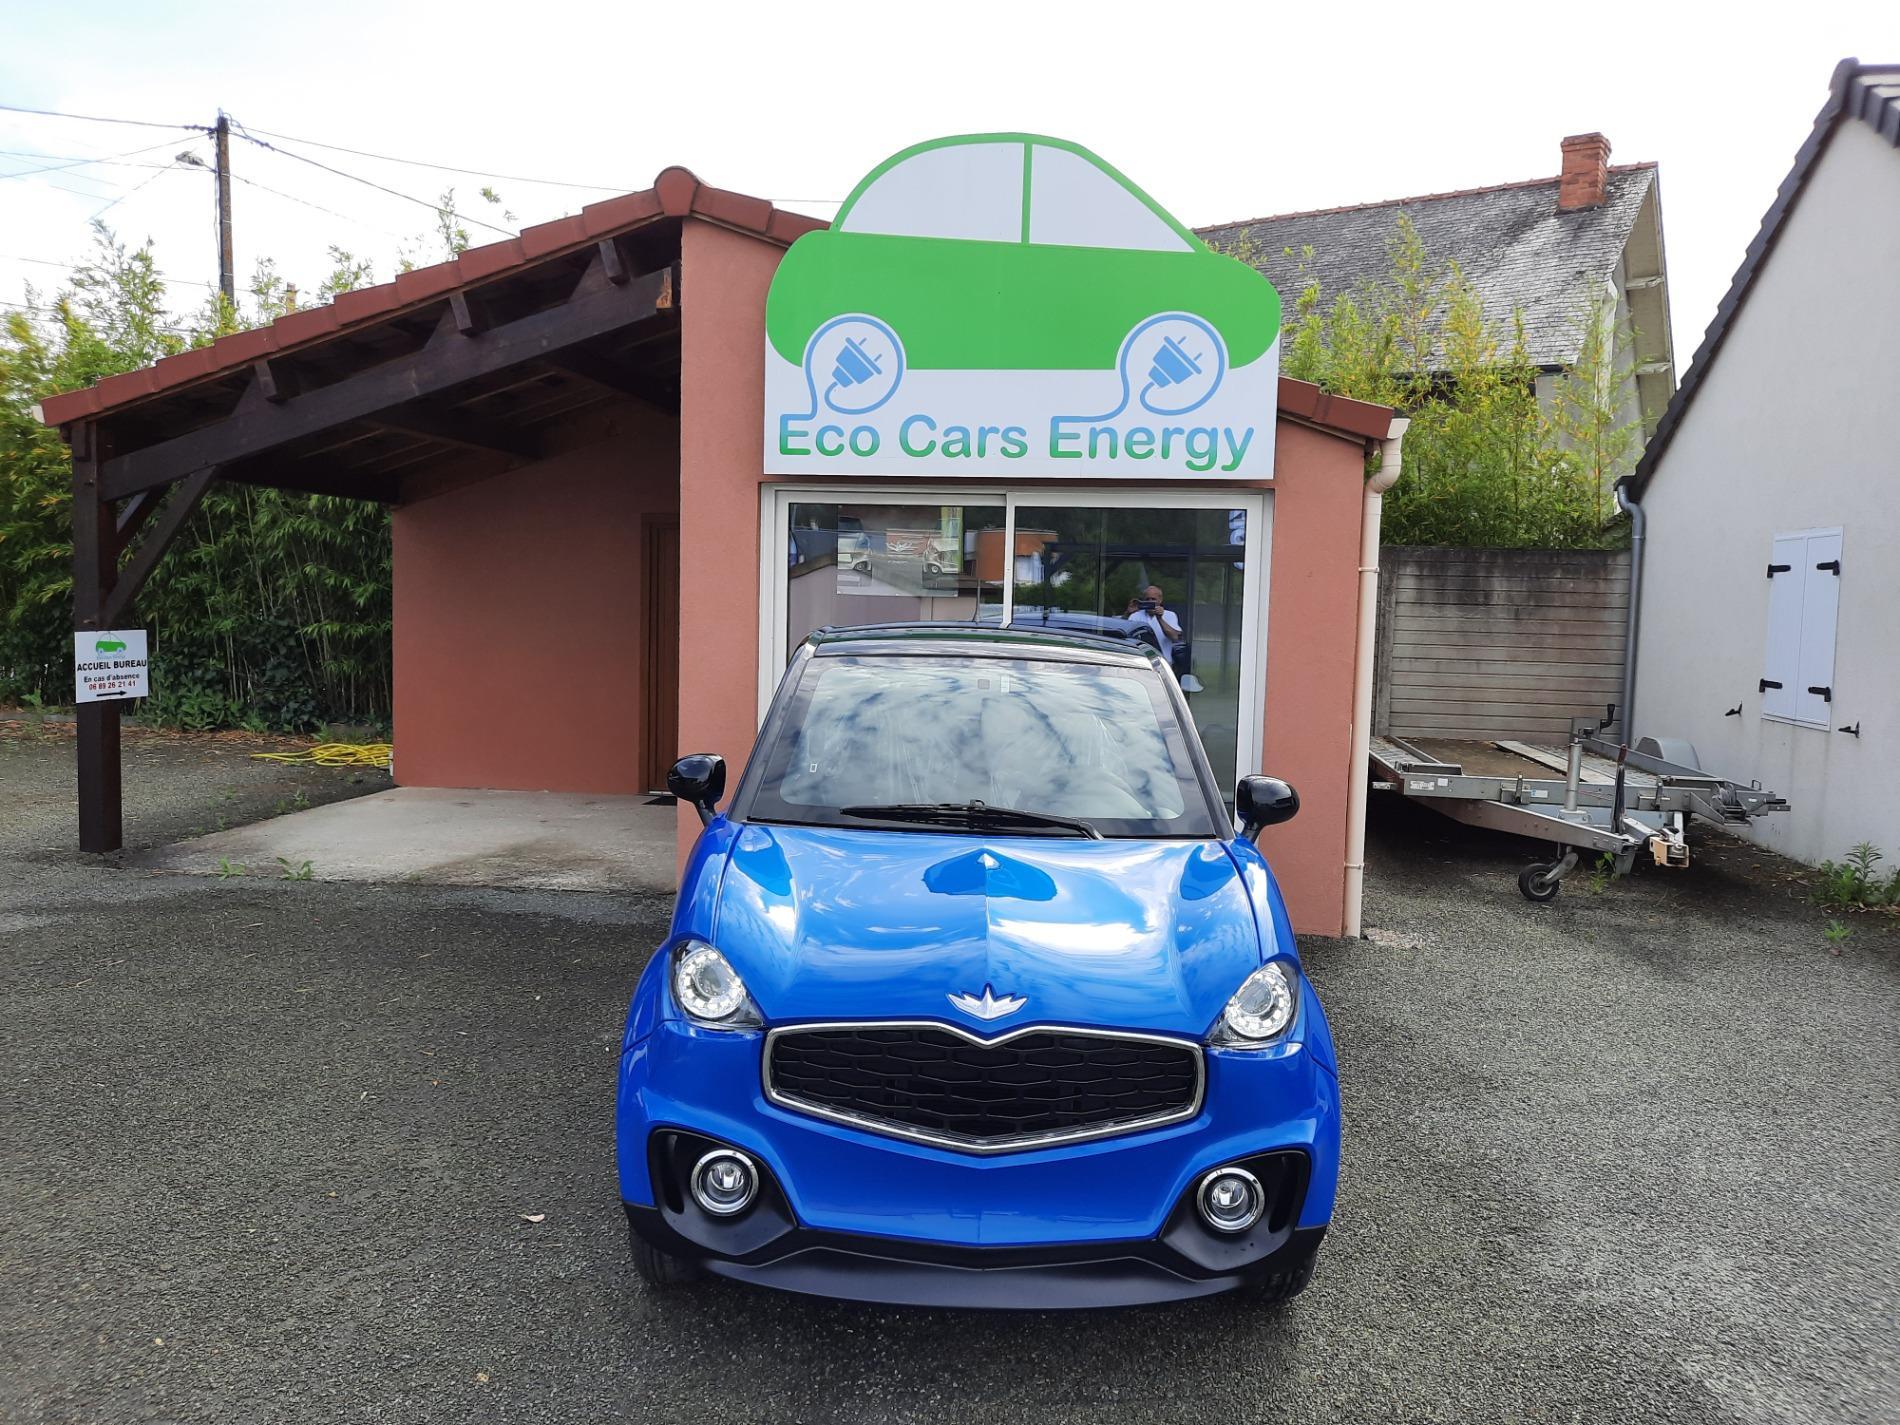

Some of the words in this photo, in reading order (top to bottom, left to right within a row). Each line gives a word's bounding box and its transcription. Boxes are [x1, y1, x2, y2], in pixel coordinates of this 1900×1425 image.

[779, 415, 881, 456] Eco
[899, 414, 1028, 459] Cars
[1049, 415, 1254, 472] Energy
[77, 662, 111, 671] ACCUEIL
[114, 659, 147, 669] BUREAU
[106, 673, 140, 681] d'absence
